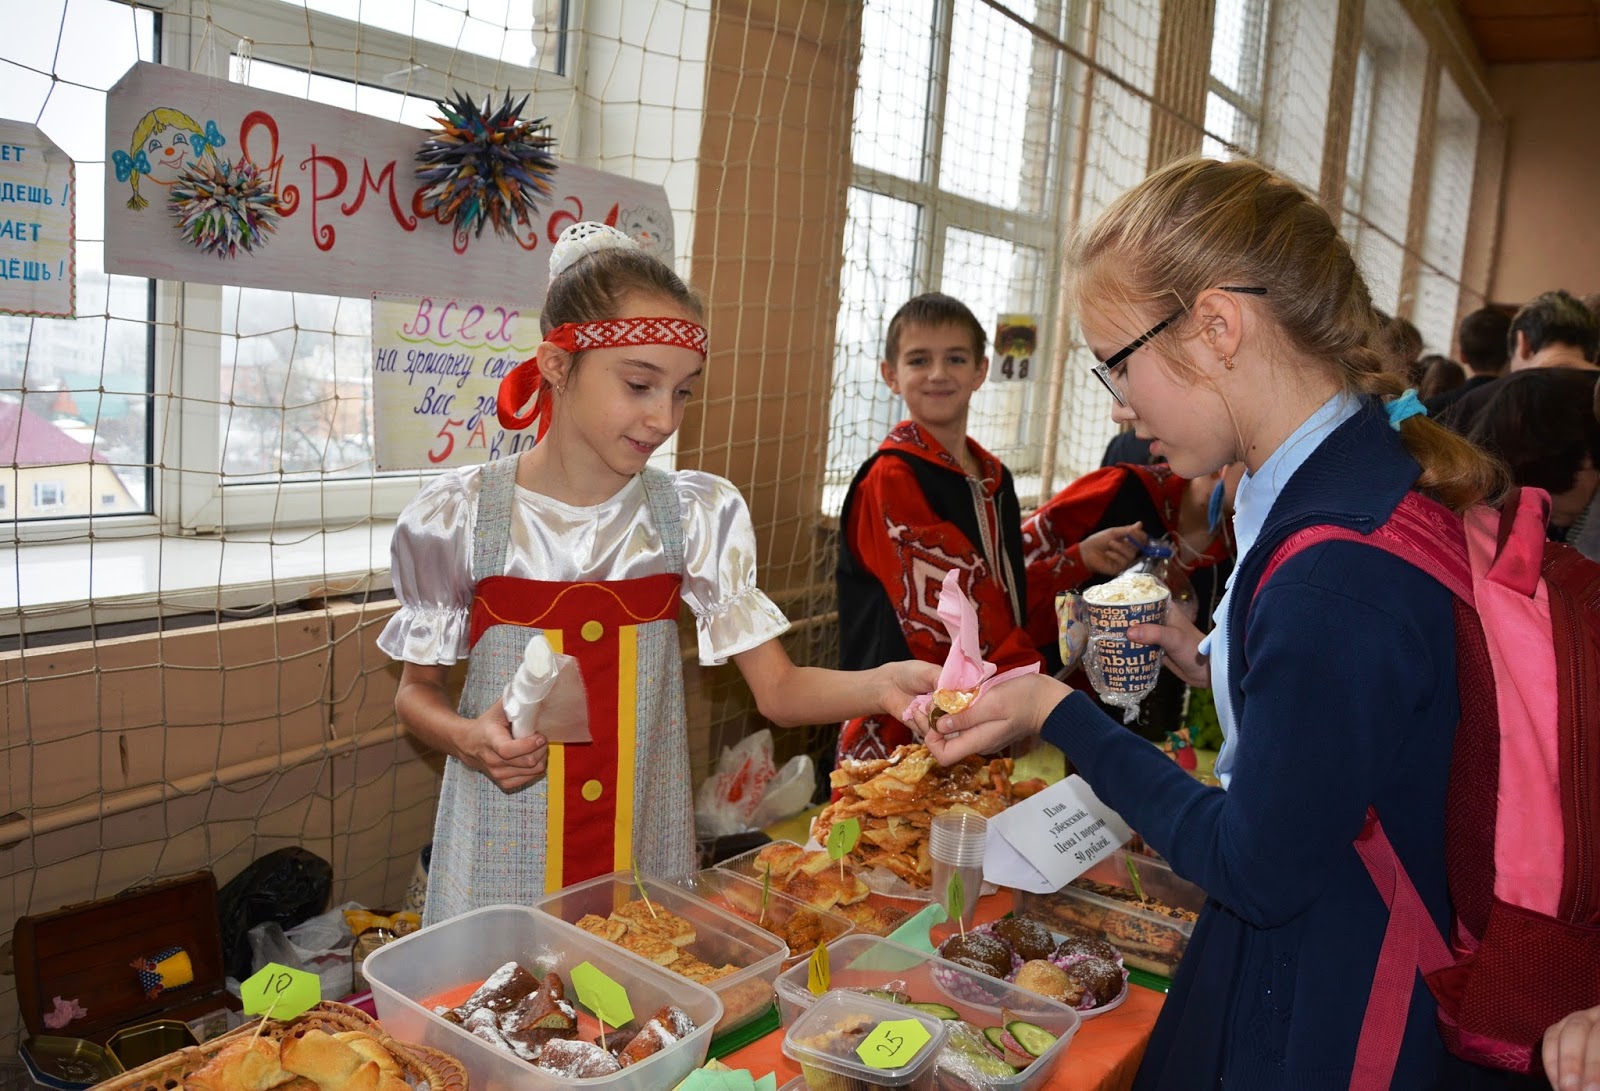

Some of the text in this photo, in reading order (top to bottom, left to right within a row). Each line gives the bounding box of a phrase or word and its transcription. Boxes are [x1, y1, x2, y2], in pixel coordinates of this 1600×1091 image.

[0, 219, 42, 242] АЕТ
[376, 347, 398, 372] на
[413, 386, 456, 416] Вас
[1090, 615, 1141, 628] Rome
[1103, 666, 1125, 675] AIRO
[1042, 802, 1067, 818] Плов
[1053, 836, 1077, 854] Цена
[1073, 832, 1082, 842] 1
[1074, 851, 1086, 864] 50
[263, 972, 293, 995] 10
